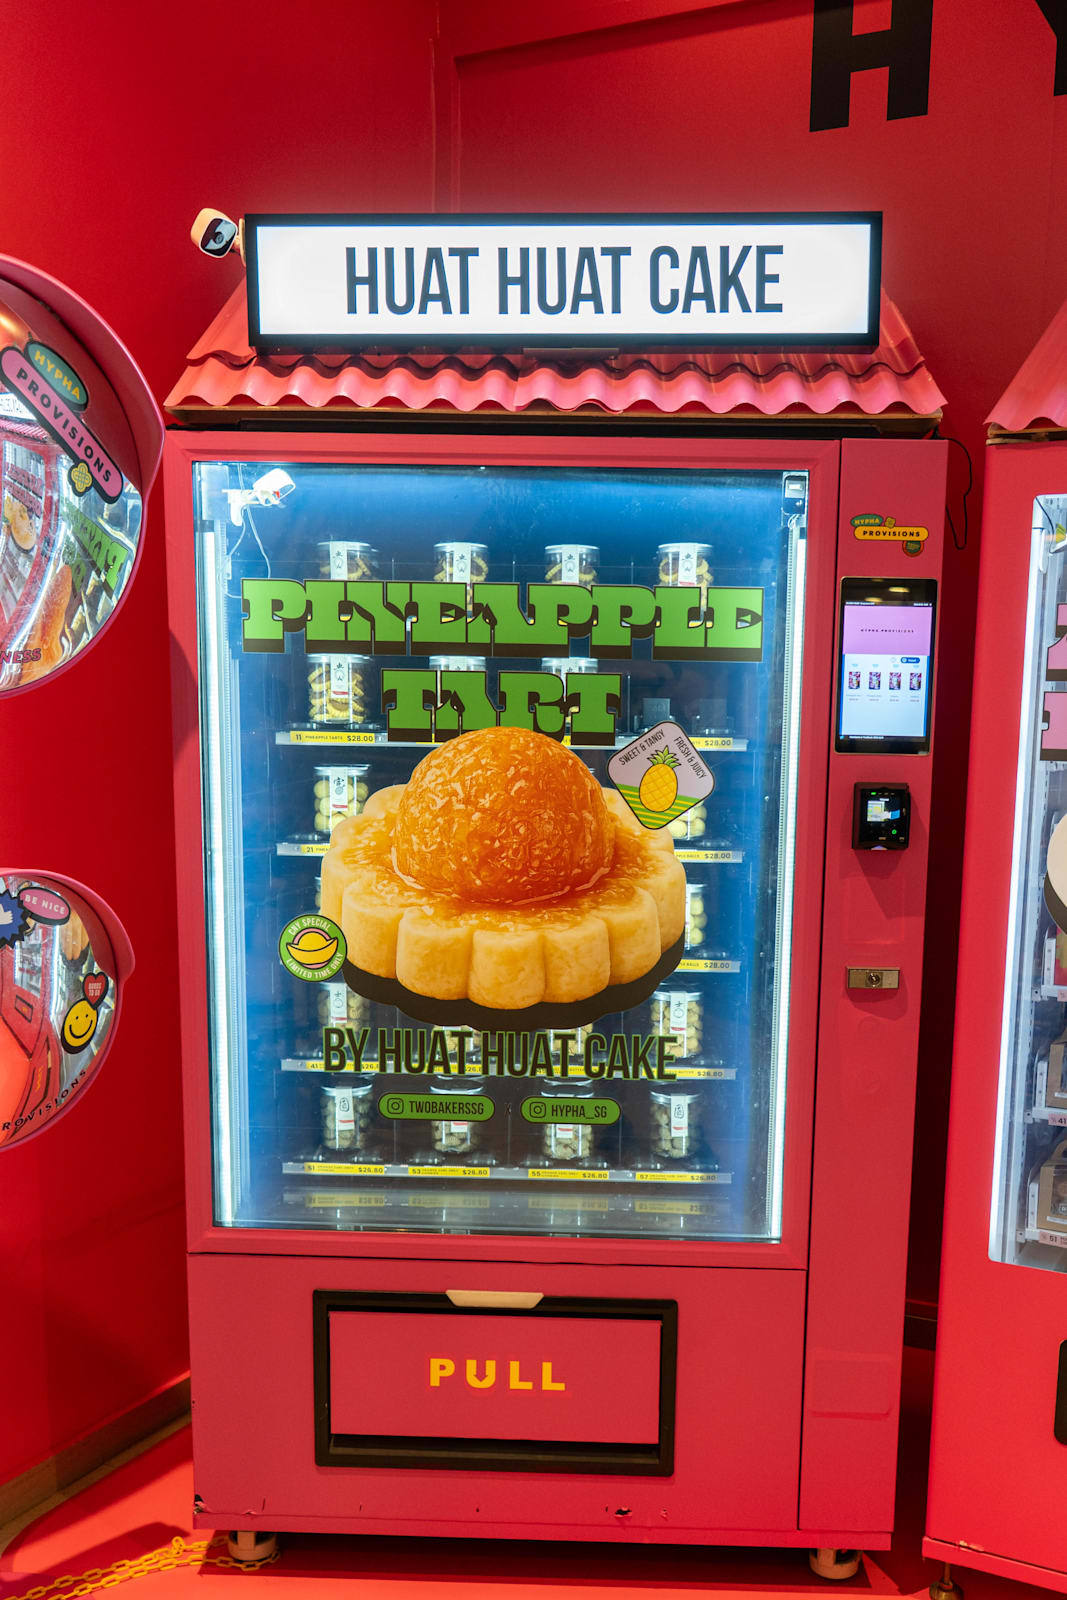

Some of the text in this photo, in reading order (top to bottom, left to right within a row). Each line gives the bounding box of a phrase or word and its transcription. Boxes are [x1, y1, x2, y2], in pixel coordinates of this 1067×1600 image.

[345, 244, 784, 315] HUAT HUAT CAKE
[34, 350, 80, 401] HYPHA
[16, 367, 113, 484] PROVISIONS
[241, 578, 764, 662] PINEAPPLE
[381, 668, 622, 746] TART
[618, 729, 665, 766] SWEET & TANGY
[674, 736, 692, 758] FRESH
[691, 762, 708, 779] JUICY
[704, 739, 732, 747] $28.00
[25, 894, 66, 915] BE NICE
[287, 917, 331, 935] CNY SPECIAL
[286, 951, 344, 979] LIMITED TIME ONLY
[703, 961, 730, 969] $28.00
[323, 1027, 678, 1082] BY HUAT HUAT CAKE
[409, 1101, 484, 1115] TWOBAKERSSG
[551, 1103, 607, 1119] HYPHA_SG
[429, 1357, 566, 1391] PULL
